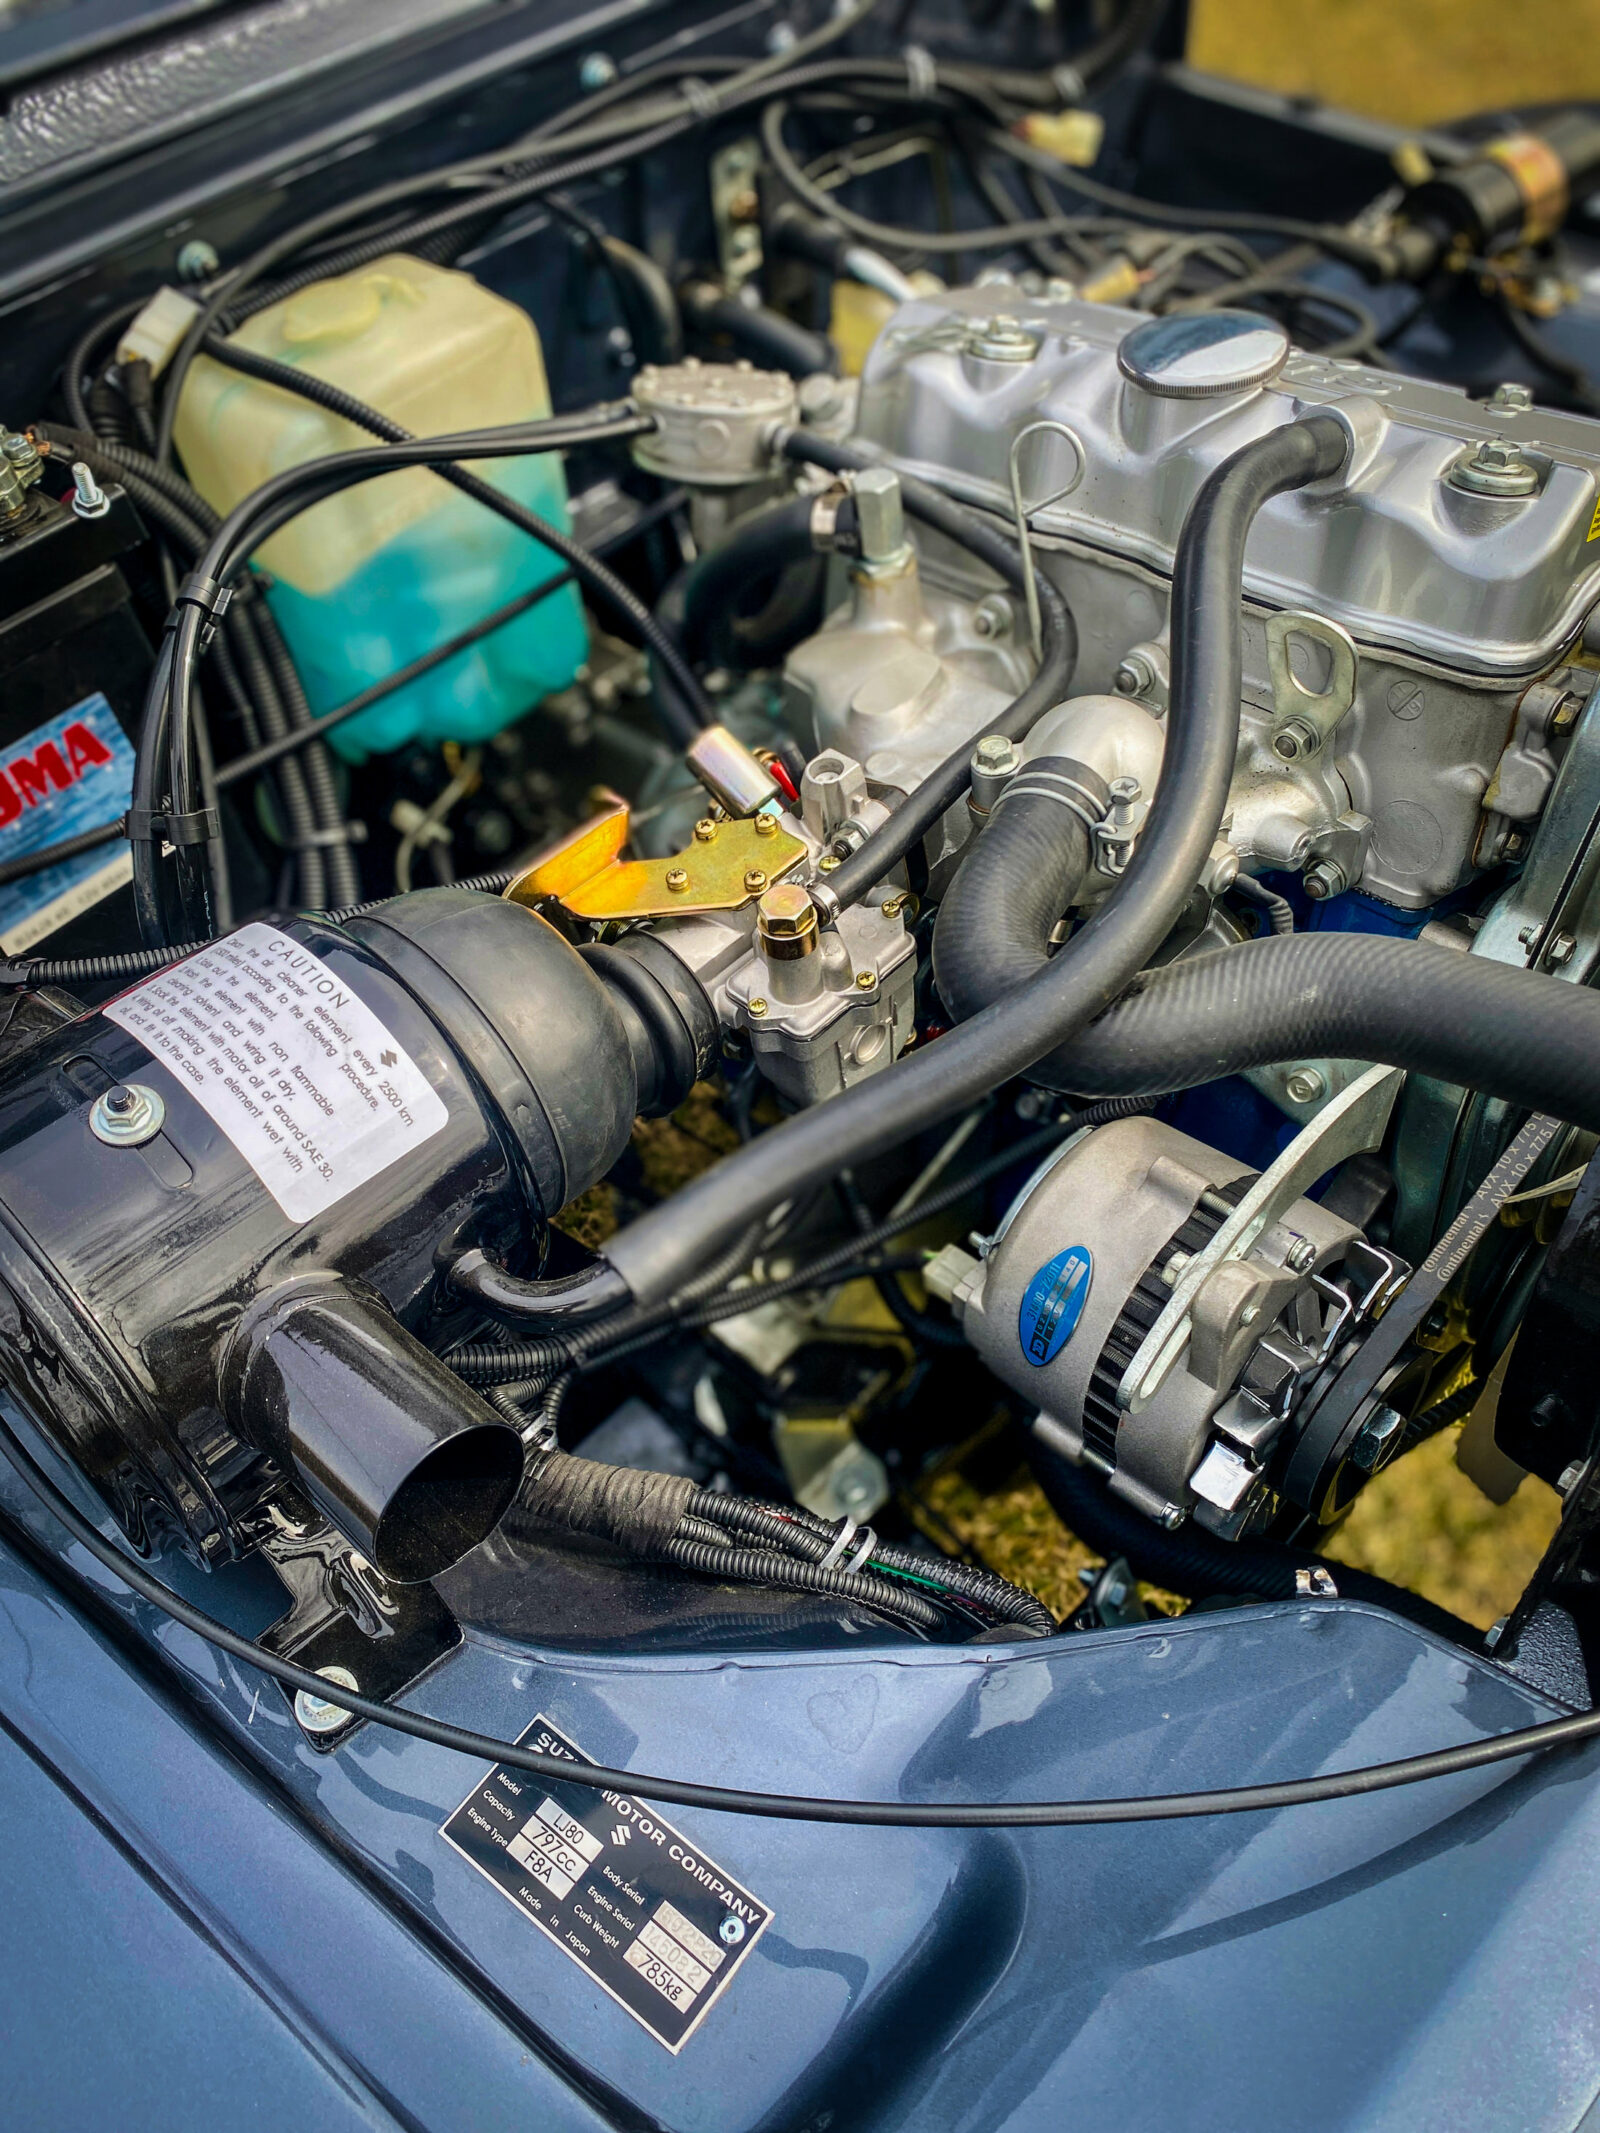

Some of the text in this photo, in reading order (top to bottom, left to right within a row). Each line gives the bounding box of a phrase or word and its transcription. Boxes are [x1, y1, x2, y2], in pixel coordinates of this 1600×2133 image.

[212, 967, 228, 976] out
[226, 975, 240, 987] the
[244, 991, 278, 1022] element.
[268, 940, 350, 1010] CAUTION
[129, 1013, 147, 1025] and
[152, 1031, 165, 1039] it
[159, 1036, 170, 1047] to
[167, 1045, 184, 1061] the
[182, 1060, 204, 1085] case.
[194, 995, 221, 1017] solvent
[222, 1020, 243, 1038] and
[244, 1040, 266, 1065] wring
[268, 1068, 280, 1078] it
[278, 1080, 296, 1101] dry.
[199, 977, 213, 988] the
[215, 990, 247, 1015] element
[247, 1018, 265, 1036] with
[269, 1041, 289, 1062] non
[290, 1065, 334, 1117] flammable
[242, 965, 276, 993] according
[277, 993, 288, 1004] to
[289, 1004, 304, 1019] the
[304, 1019, 338, 1058] following
[338, 1063, 379, 1111] procedure.
[261, 959, 275, 968] air
[277, 971, 308, 997] cleaner
[314, 1006, 353, 1044] element
[353, 1049, 378, 1076] every
[378, 1080, 403, 1108] 2500
[398, 1107, 414, 1127] km
[152, 1008, 166, 1017] oil
[162, 1016, 176, 1026] off
[207, 1057, 224, 1075] the
[224, 1077, 264, 1118] element
[263, 1121, 284, 1144] wet
[282, 1146, 305, 1173] with
[167, 995, 180, 1006] the
[179, 1007, 211, 1033] element
[208, 1031, 225, 1048] with
[222, 1047, 251, 1074] motor
[249, 1075, 265, 1089] oil
[262, 1090, 277, 1102] of
[273, 1104, 306, 1141] around
[302, 1140, 324, 1165] SAE
[318, 1162, 334, 1182] 30.
[1436, 1220, 1486, 1282] Continental
[1490, 1179, 1517, 1209] AVX
[1511, 1163, 1528, 1178] 10
[1529, 1129, 1552, 1151] 775
[1546, 1121, 1562, 1129] L
[1476, 1173, 1500, 1200] AVX
[1496, 1155, 1511, 1169] 10
[482, 1789, 516, 1822] Capacity
[497, 1772, 522, 1796] Model
[467, 1807, 509, 1848] Engine Type
[553, 1813, 584, 1845] LJ80
[601, 1790, 667, 1846] MOTOR
[668, 1844, 761, 1924] COMPANY
[524, 1850, 553, 1884] F8A
[602, 1865, 646, 1906] Body Serial
[518, 1886, 591, 1957] Made in Japan
[573, 1904, 621, 1949] Curb Weight
[587, 1885, 636, 1931] Engine Serial
[637, 1954, 684, 2001] 785kg
